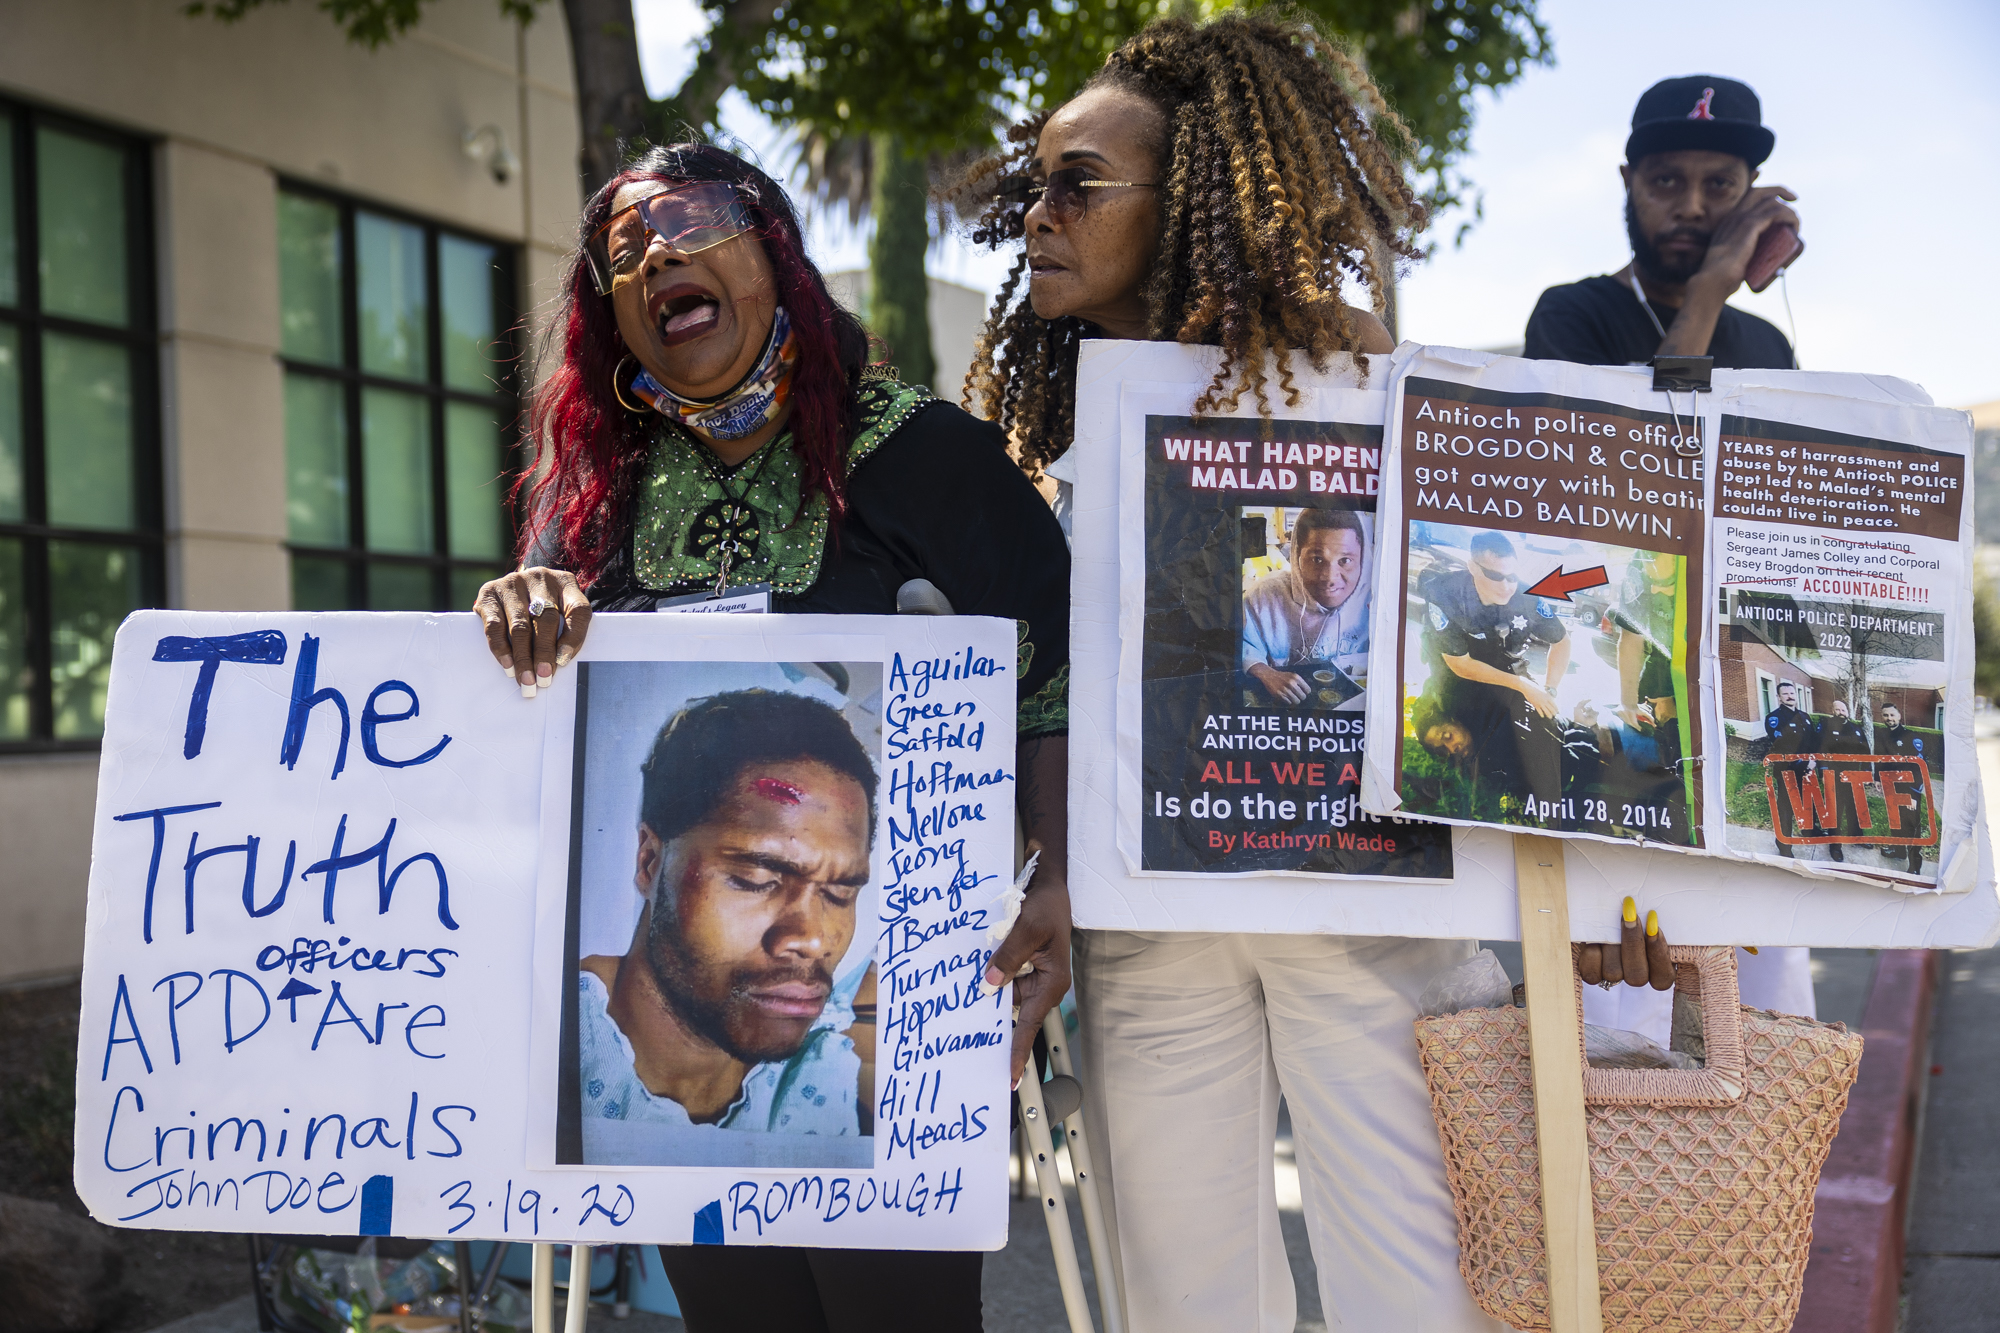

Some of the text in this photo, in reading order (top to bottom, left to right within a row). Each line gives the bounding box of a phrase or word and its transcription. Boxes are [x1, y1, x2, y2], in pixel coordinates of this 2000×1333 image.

[1415, 400, 1521, 430] Antioch
[1534, 412, 1617, 438] police
[1164, 438, 1252, 463] WHAT
[1415, 431, 1575, 464] BROGDON
[1588, 445, 1608, 467] &
[1722, 441, 1940, 473] YEARS of harrassment and
[1192, 466, 1298, 490] MALAD
[1415, 466, 1459, 486] got
[1471, 471, 1548, 498] away
[1559, 474, 1615, 499] with
[1723, 456, 1958, 489] abuse by the Antioch POLICE
[1723, 471, 1946, 504] Dept led to Malad's mental
[1416, 488, 1683, 541] MALAD BALDWIN.
[1722, 503, 1899, 528] couldnt live in peace.
[1723, 485, 1921, 516] health deterioration. He
[1727, 527, 1911, 554] Please join us in congratulating
[1727, 541, 1940, 570] Sergeant James Colley and Corporal
[1726, 556, 1904, 581] Casey Brogdon on their recent
[1726, 573, 1929, 603] promotions! ACCOUNTABLE!!!!
[1736, 605, 1935, 636] ANTIOCH POLICE DEPARTMENT
[1820, 632, 1851, 649] 2022
[889, 646, 1006, 698] Aguilar
[152, 629, 452, 781] The
[886, 694, 976, 729] Green
[1203, 715, 1364, 734] AT THE HANDS
[1202, 734, 1301, 751] ANTIOCH
[889, 761, 1015, 813] Hoffman
[1200, 760, 1261, 785] ALL
[1270, 761, 1326, 786] WE
[1155, 791, 1382, 828] Is do the righ
[1524, 793, 1672, 829] April 28, 2014
[1781, 769, 1915, 830] WTF
[888, 801, 986, 851] Mellone
[1208, 830, 1396, 853] By Kathryn Wade
[113, 801, 459, 944] Truth
[883, 839, 969, 889] Jeong
[256, 936, 459, 978] officers
[880, 948, 992, 1004] Turnage
[101, 969, 447, 1081] APD Are
[104, 1086, 477, 1172] Criminals
[887, 1103, 990, 1160] Meads
[118, 1168, 358, 1222] John Doe
